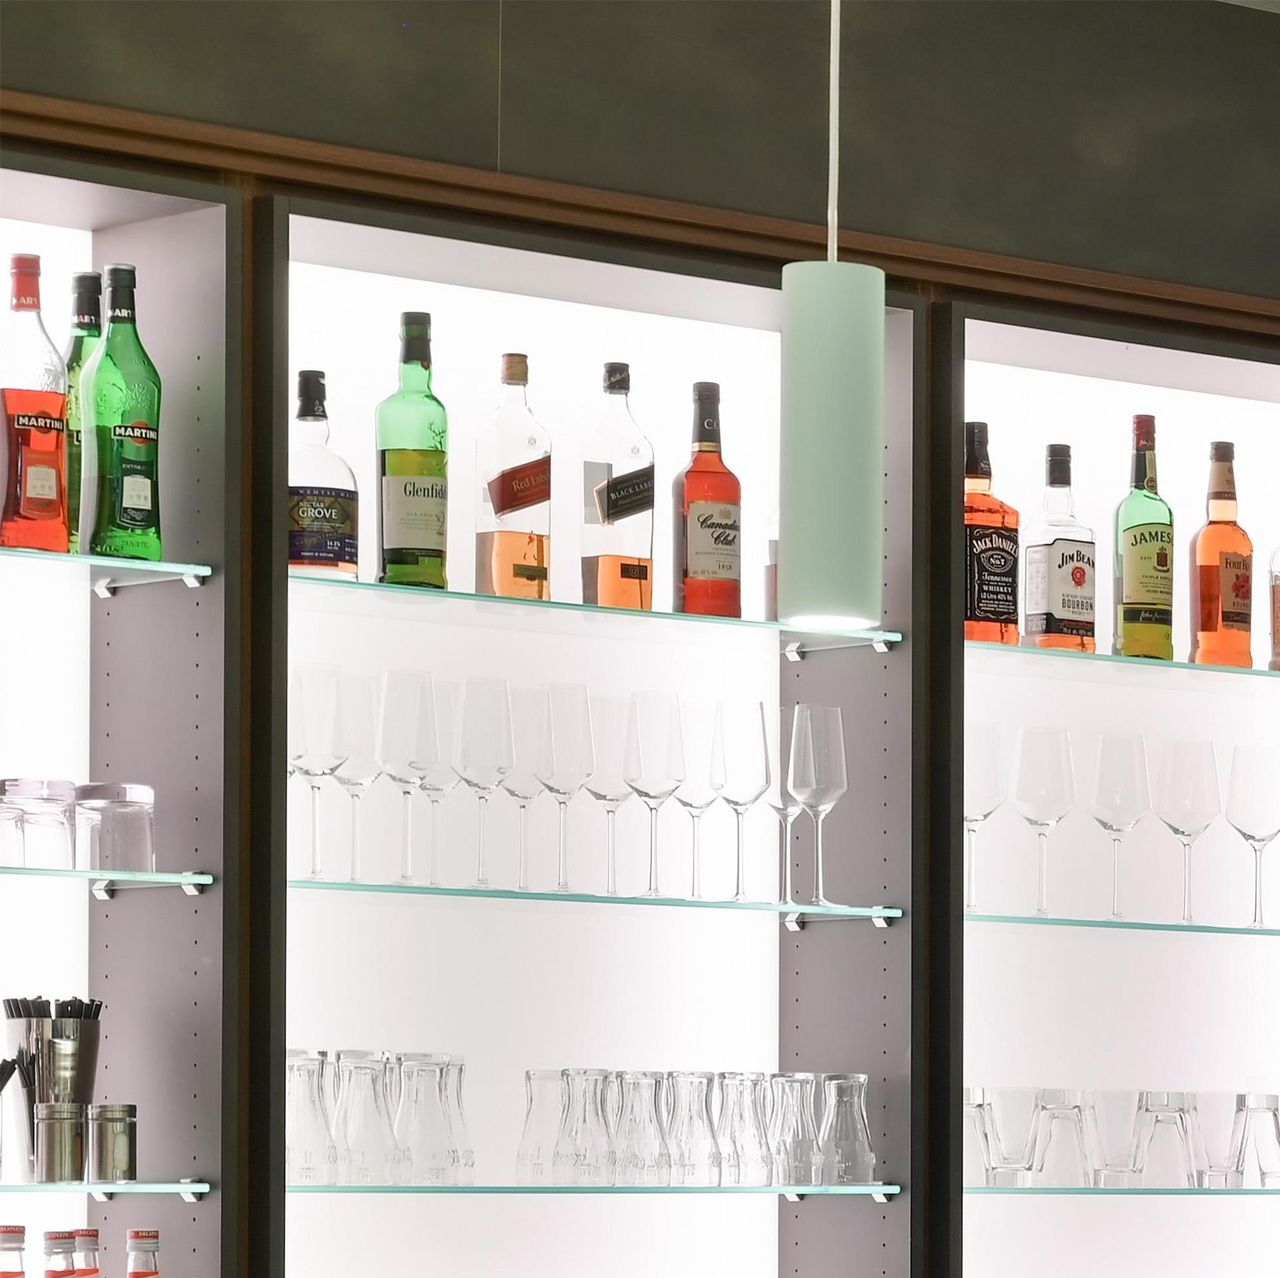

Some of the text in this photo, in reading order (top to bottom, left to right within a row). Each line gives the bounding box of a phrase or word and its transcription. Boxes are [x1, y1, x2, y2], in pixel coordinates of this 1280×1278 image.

[18, 415, 63, 430] MARTINI
[115, 426, 157, 440] MARTINI
[512, 477, 530, 491] Red
[610, 487, 634, 500] BLACK
[298, 507, 338, 519] GROVE
[711, 530, 737, 546] Club
[972, 537, 993, 554] JACK
[1057, 552, 1075, 569] JIM
[1061, 598, 1094, 611] BOURBON
